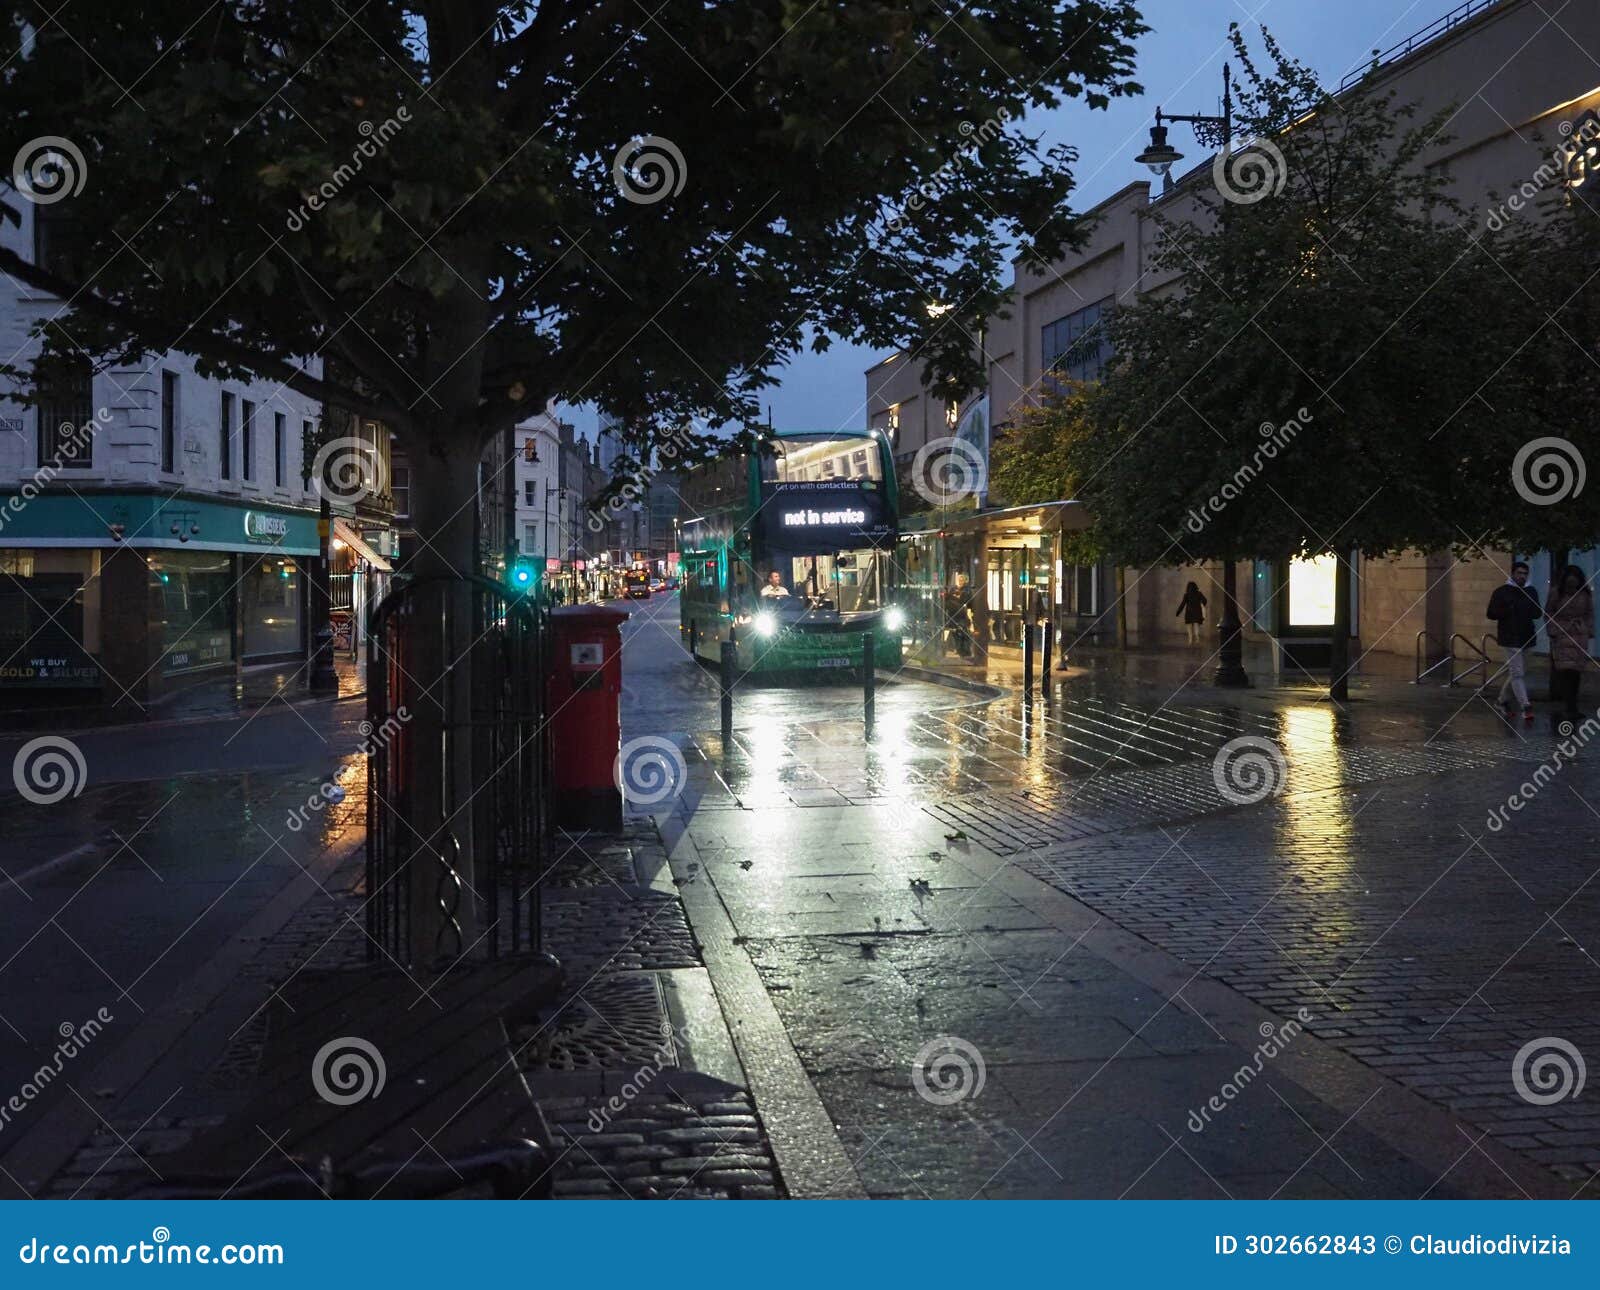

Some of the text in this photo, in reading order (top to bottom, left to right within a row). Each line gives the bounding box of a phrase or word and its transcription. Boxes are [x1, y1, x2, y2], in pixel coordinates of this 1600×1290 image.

[816, 481, 858, 489] contactless
[784, 508, 865, 525] not in service
[0, 667, 99, 677] GOLD & SILVER
